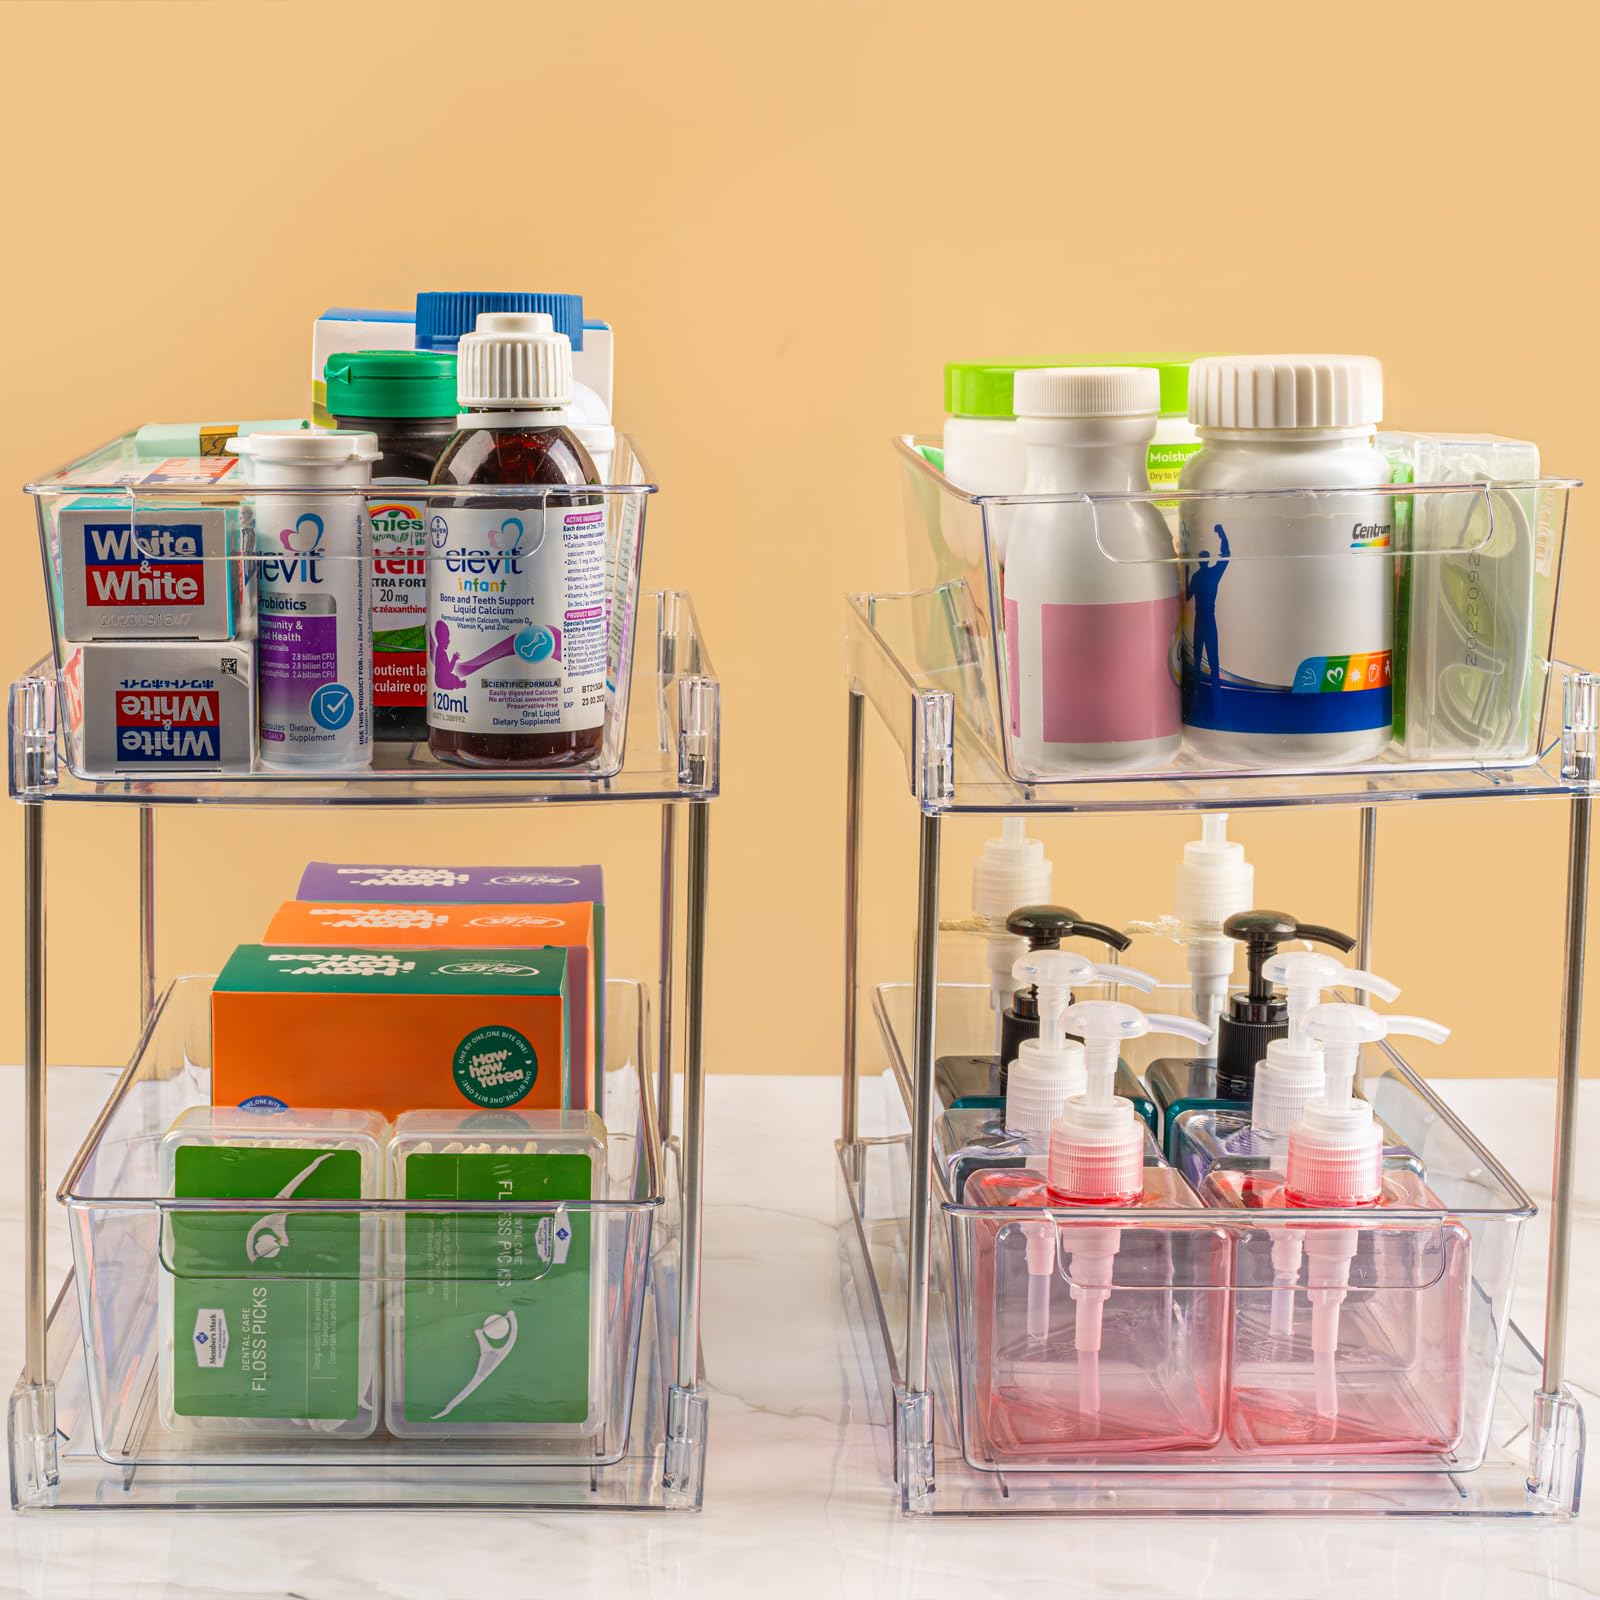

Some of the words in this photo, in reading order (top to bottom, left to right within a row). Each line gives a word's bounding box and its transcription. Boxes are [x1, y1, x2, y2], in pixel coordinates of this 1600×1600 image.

[1150, 472, 1164, 480] Dry
[1352, 523, 1391, 540] Centrum
[91, 530, 197, 560] White
[139, 560, 151, 574] &
[256, 547, 325, 584] levit
[445, 547, 523, 575] elevit
[92, 570, 198, 601] White
[399, 578, 426, 588] FORT
[458, 577, 507, 592] infant
[380, 589, 394, 602] 20
[395, 594, 408, 604] mg
[440, 593, 455, 603] Bone
[457, 596, 470, 604] and
[472, 596, 497, 604] Teeth
[498, 596, 535, 607] Support
[379, 604, 427, 614] zéaxanthine
[453, 604, 476, 615] Liquid
[478, 606, 514, 615] Calcium
[295, 620, 303, 630] &
[272, 631, 301, 642] Health
[292, 653, 301, 661] 2.8
[302, 652, 321, 661] billion
[321, 652, 335, 660] CFU
[292, 662, 301, 670] 2.8
[302, 661, 321, 670] billion
[321, 661, 335, 669] CFU
[374, 663, 414, 676] outient
[416, 663, 427, 676] la
[302, 670, 321, 679] billion
[321, 670, 335, 678] CFU
[374, 680, 411, 692] culaire
[413, 685, 427, 695] op
[525, 680, 559, 688] FORMULA
[489, 689, 507, 697] Easily
[508, 689, 534, 697] digested
[121, 695, 214, 721] White
[433, 691, 469, 714] 120ml
[522, 710, 537, 718] Oral
[539, 709, 560, 718] Liquid
[582, 698, 589, 706] 23
[162, 719, 172, 731] &
[289, 723, 317, 734] Dietary
[492, 718, 518, 727] Dietary
[520, 717, 561, 726] Supplement
[122, 730, 215, 757] White
[289, 733, 336, 743] Supplement
[458, 1050, 468, 1064] ONE
[464, 1043, 473, 1052] BY
[501, 1031, 515, 1042] BITE
[524, 1071, 532, 1085] ONE
[518, 1085, 526, 1094] BY
[474, 1092, 488, 1103] BITE
[252, 1287, 267, 1335] PICKS
[209, 1313, 217, 1332] Mark
[242, 1307, 250, 1333] CARE
[209, 1332, 217, 1365] Member's
[242, 1335, 250, 1371] DENTAL
[252, 1338, 267, 1391] FLOSS
